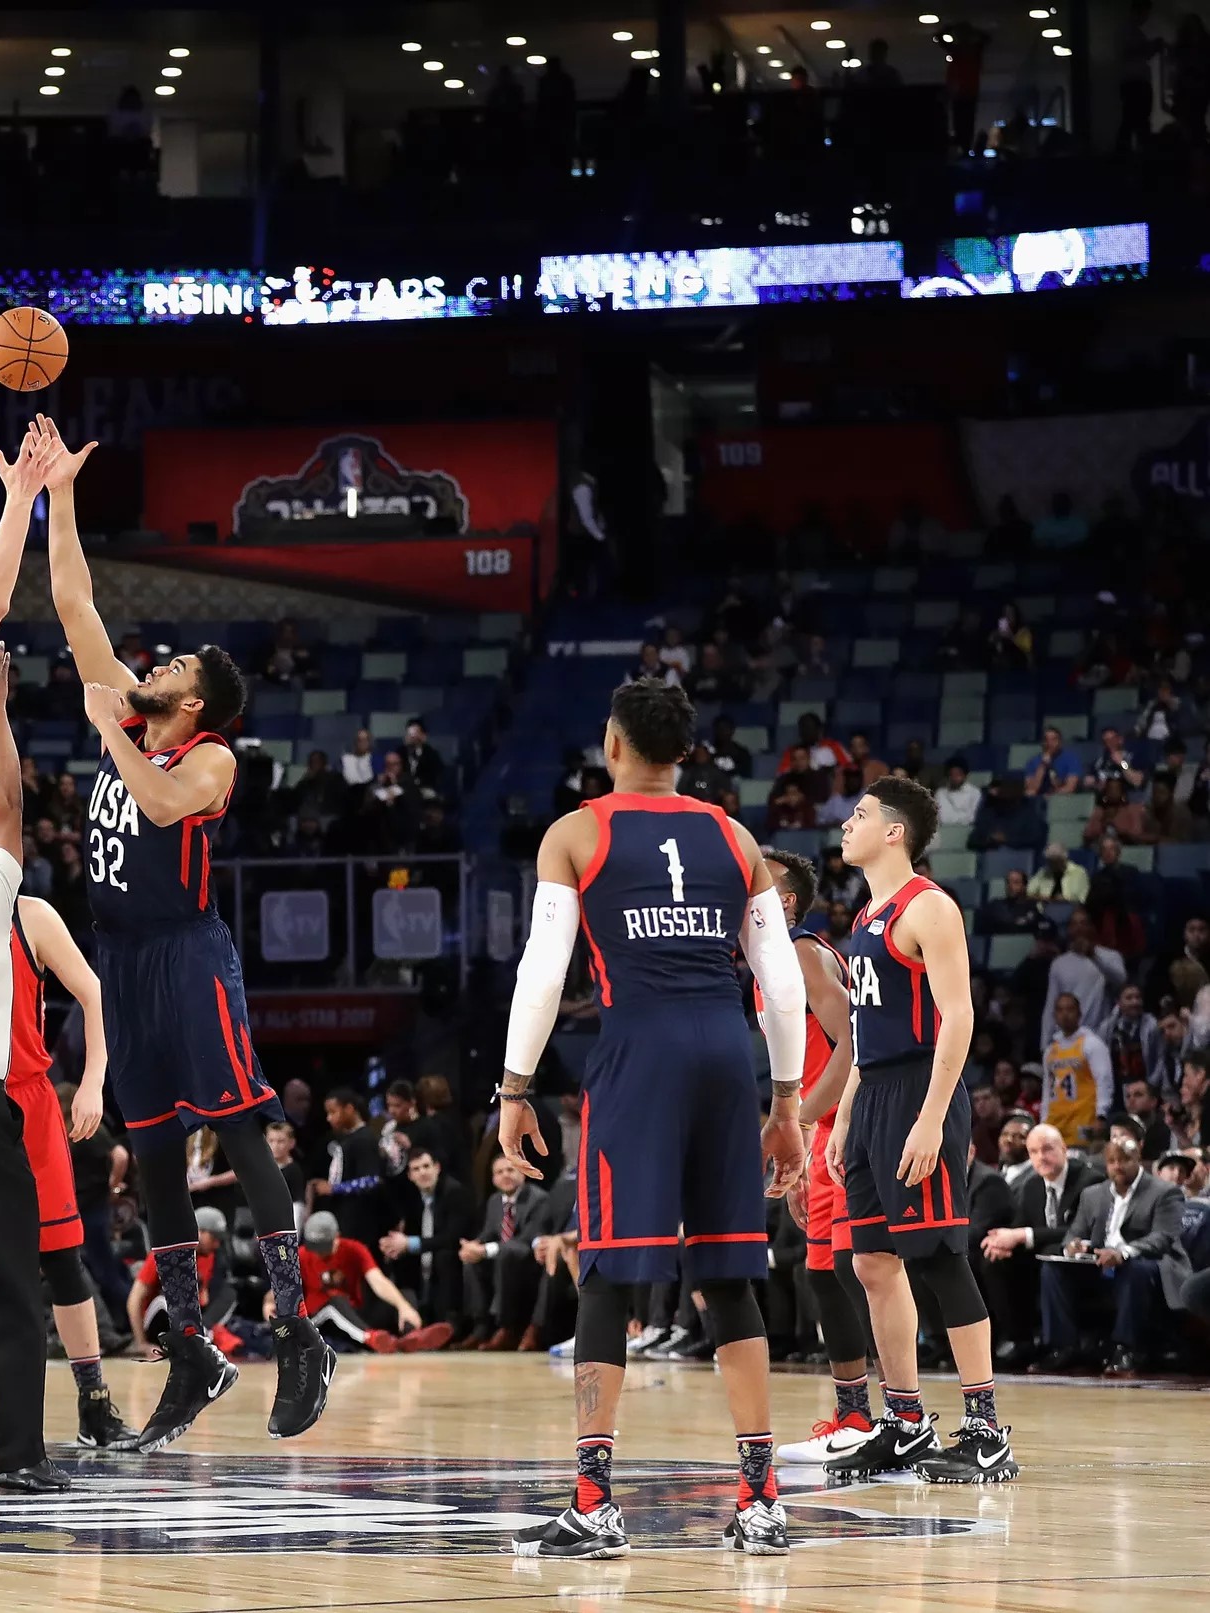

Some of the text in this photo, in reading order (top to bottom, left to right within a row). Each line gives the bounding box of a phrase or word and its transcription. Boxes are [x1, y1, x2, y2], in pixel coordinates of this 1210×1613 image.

[464, 549, 511, 575] 108
[88, 770, 140, 837] USA
[89, 827, 128, 892] 32
[658, 838, 685, 902] 1
[623, 906, 727, 940] RUSSELL
[849, 1009, 860, 1066] 1
